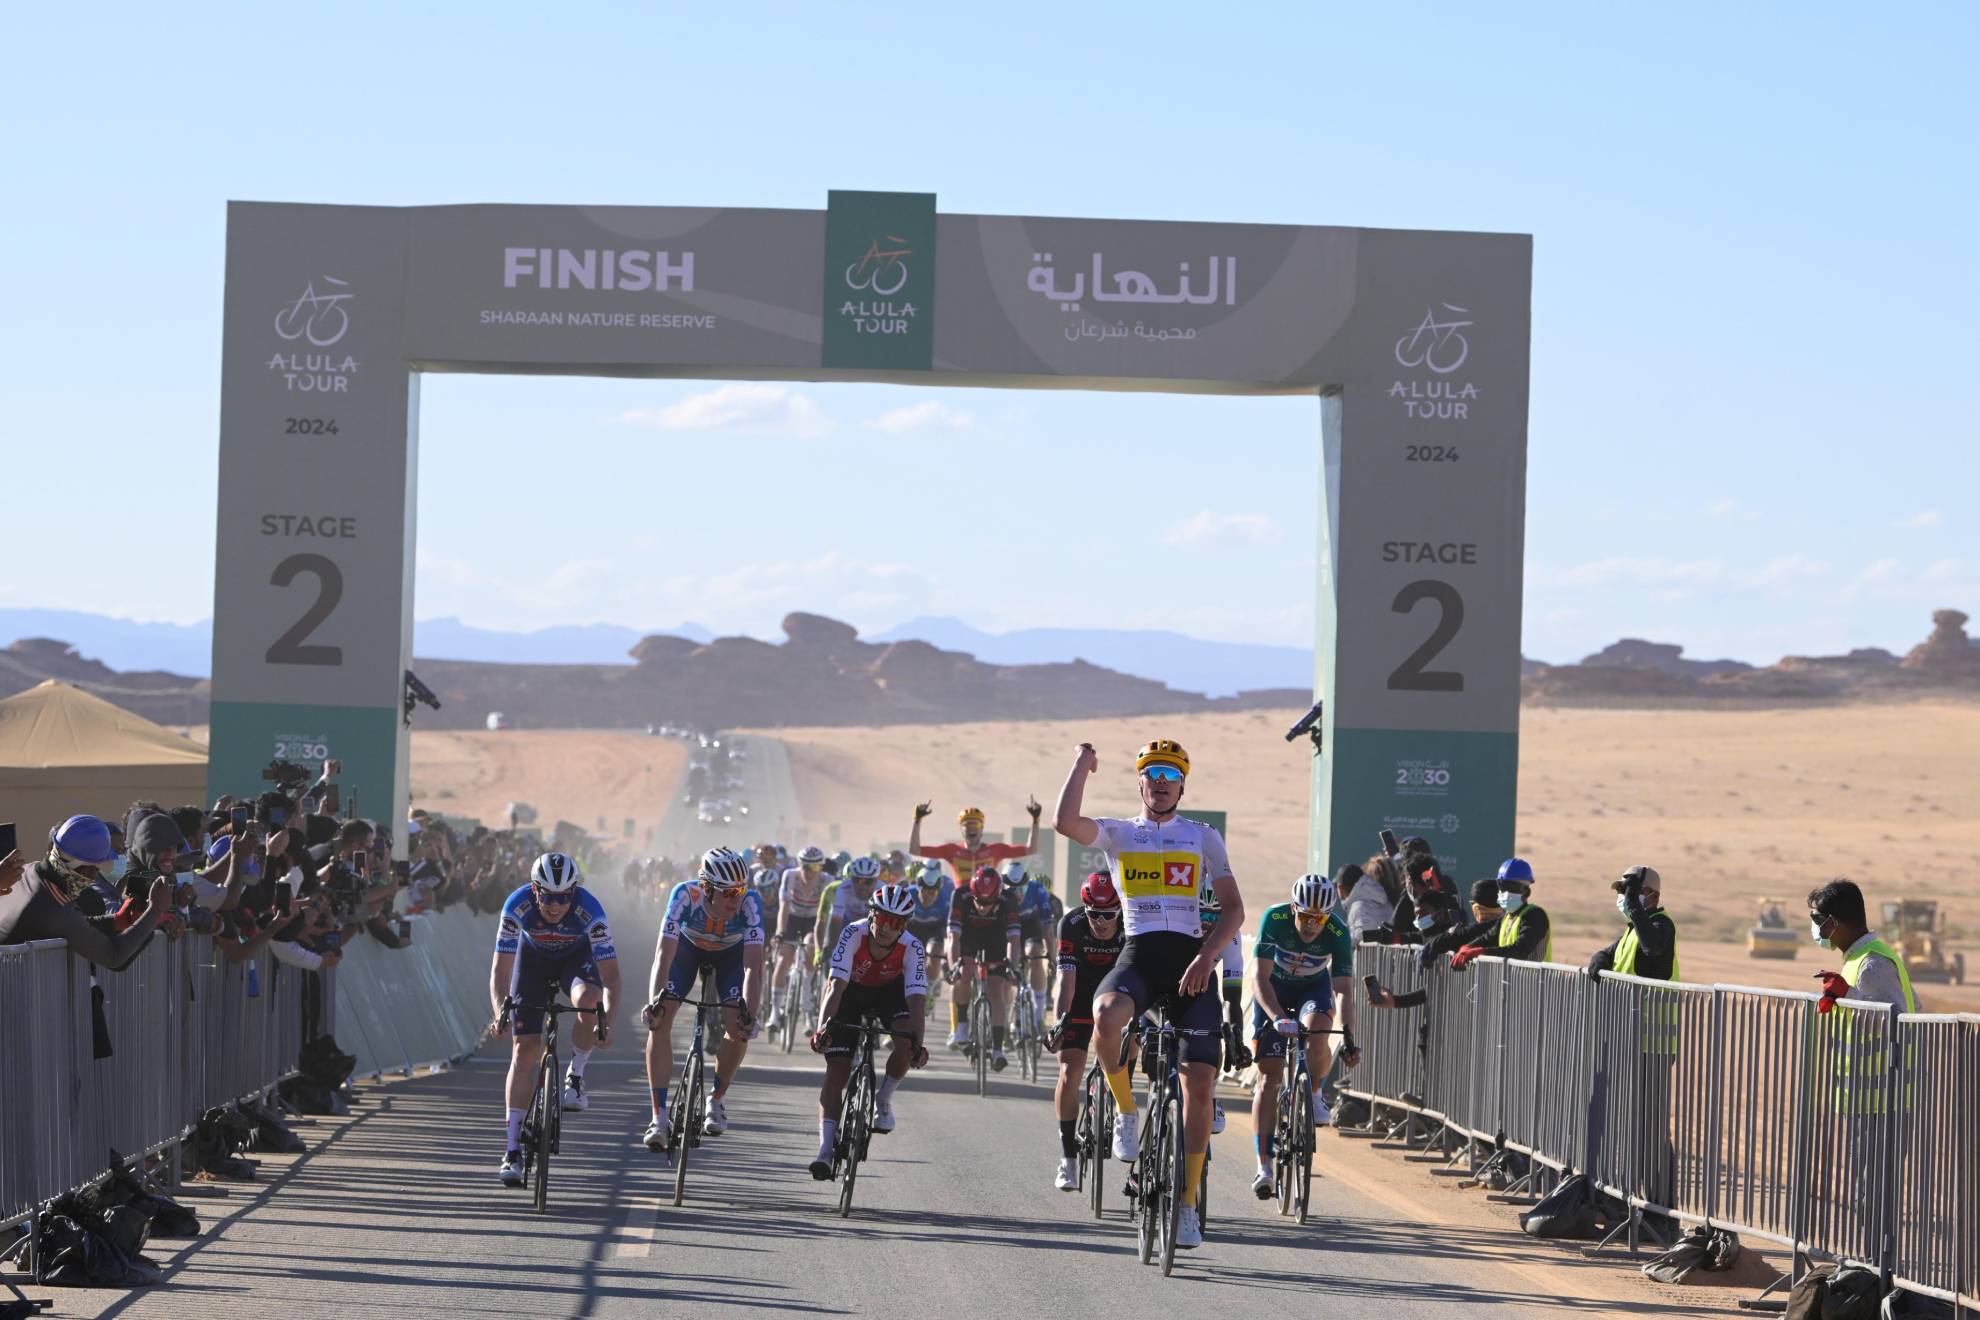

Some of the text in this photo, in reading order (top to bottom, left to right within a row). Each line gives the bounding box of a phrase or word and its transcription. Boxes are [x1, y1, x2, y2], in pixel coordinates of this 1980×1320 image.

[503, 247, 695, 292] FINISH
[1027, 252, 1236, 313] النهاية
[839, 301, 916, 317] ALULA
[480, 310, 716, 329] SHARAAN NATURE RESERVE
[853, 318, 908, 334] TOUR
[1064, 318, 1197, 342] محمية شرعان
[267, 353, 359, 373] ALULA
[283, 373, 348, 393] TOUR
[1388, 380, 1480, 400] ALULA
[1404, 401, 1468, 420] TOUR
[285, 417, 339, 436] 2024
[1405, 444, 1460, 463] 2024
[261, 514, 356, 539] STAGE
[1382, 541, 1478, 565] STAGE
[265, 552, 343, 667] 2
[1386, 579, 1465, 693] 2
[1125, 865, 1193, 886] Uno X
